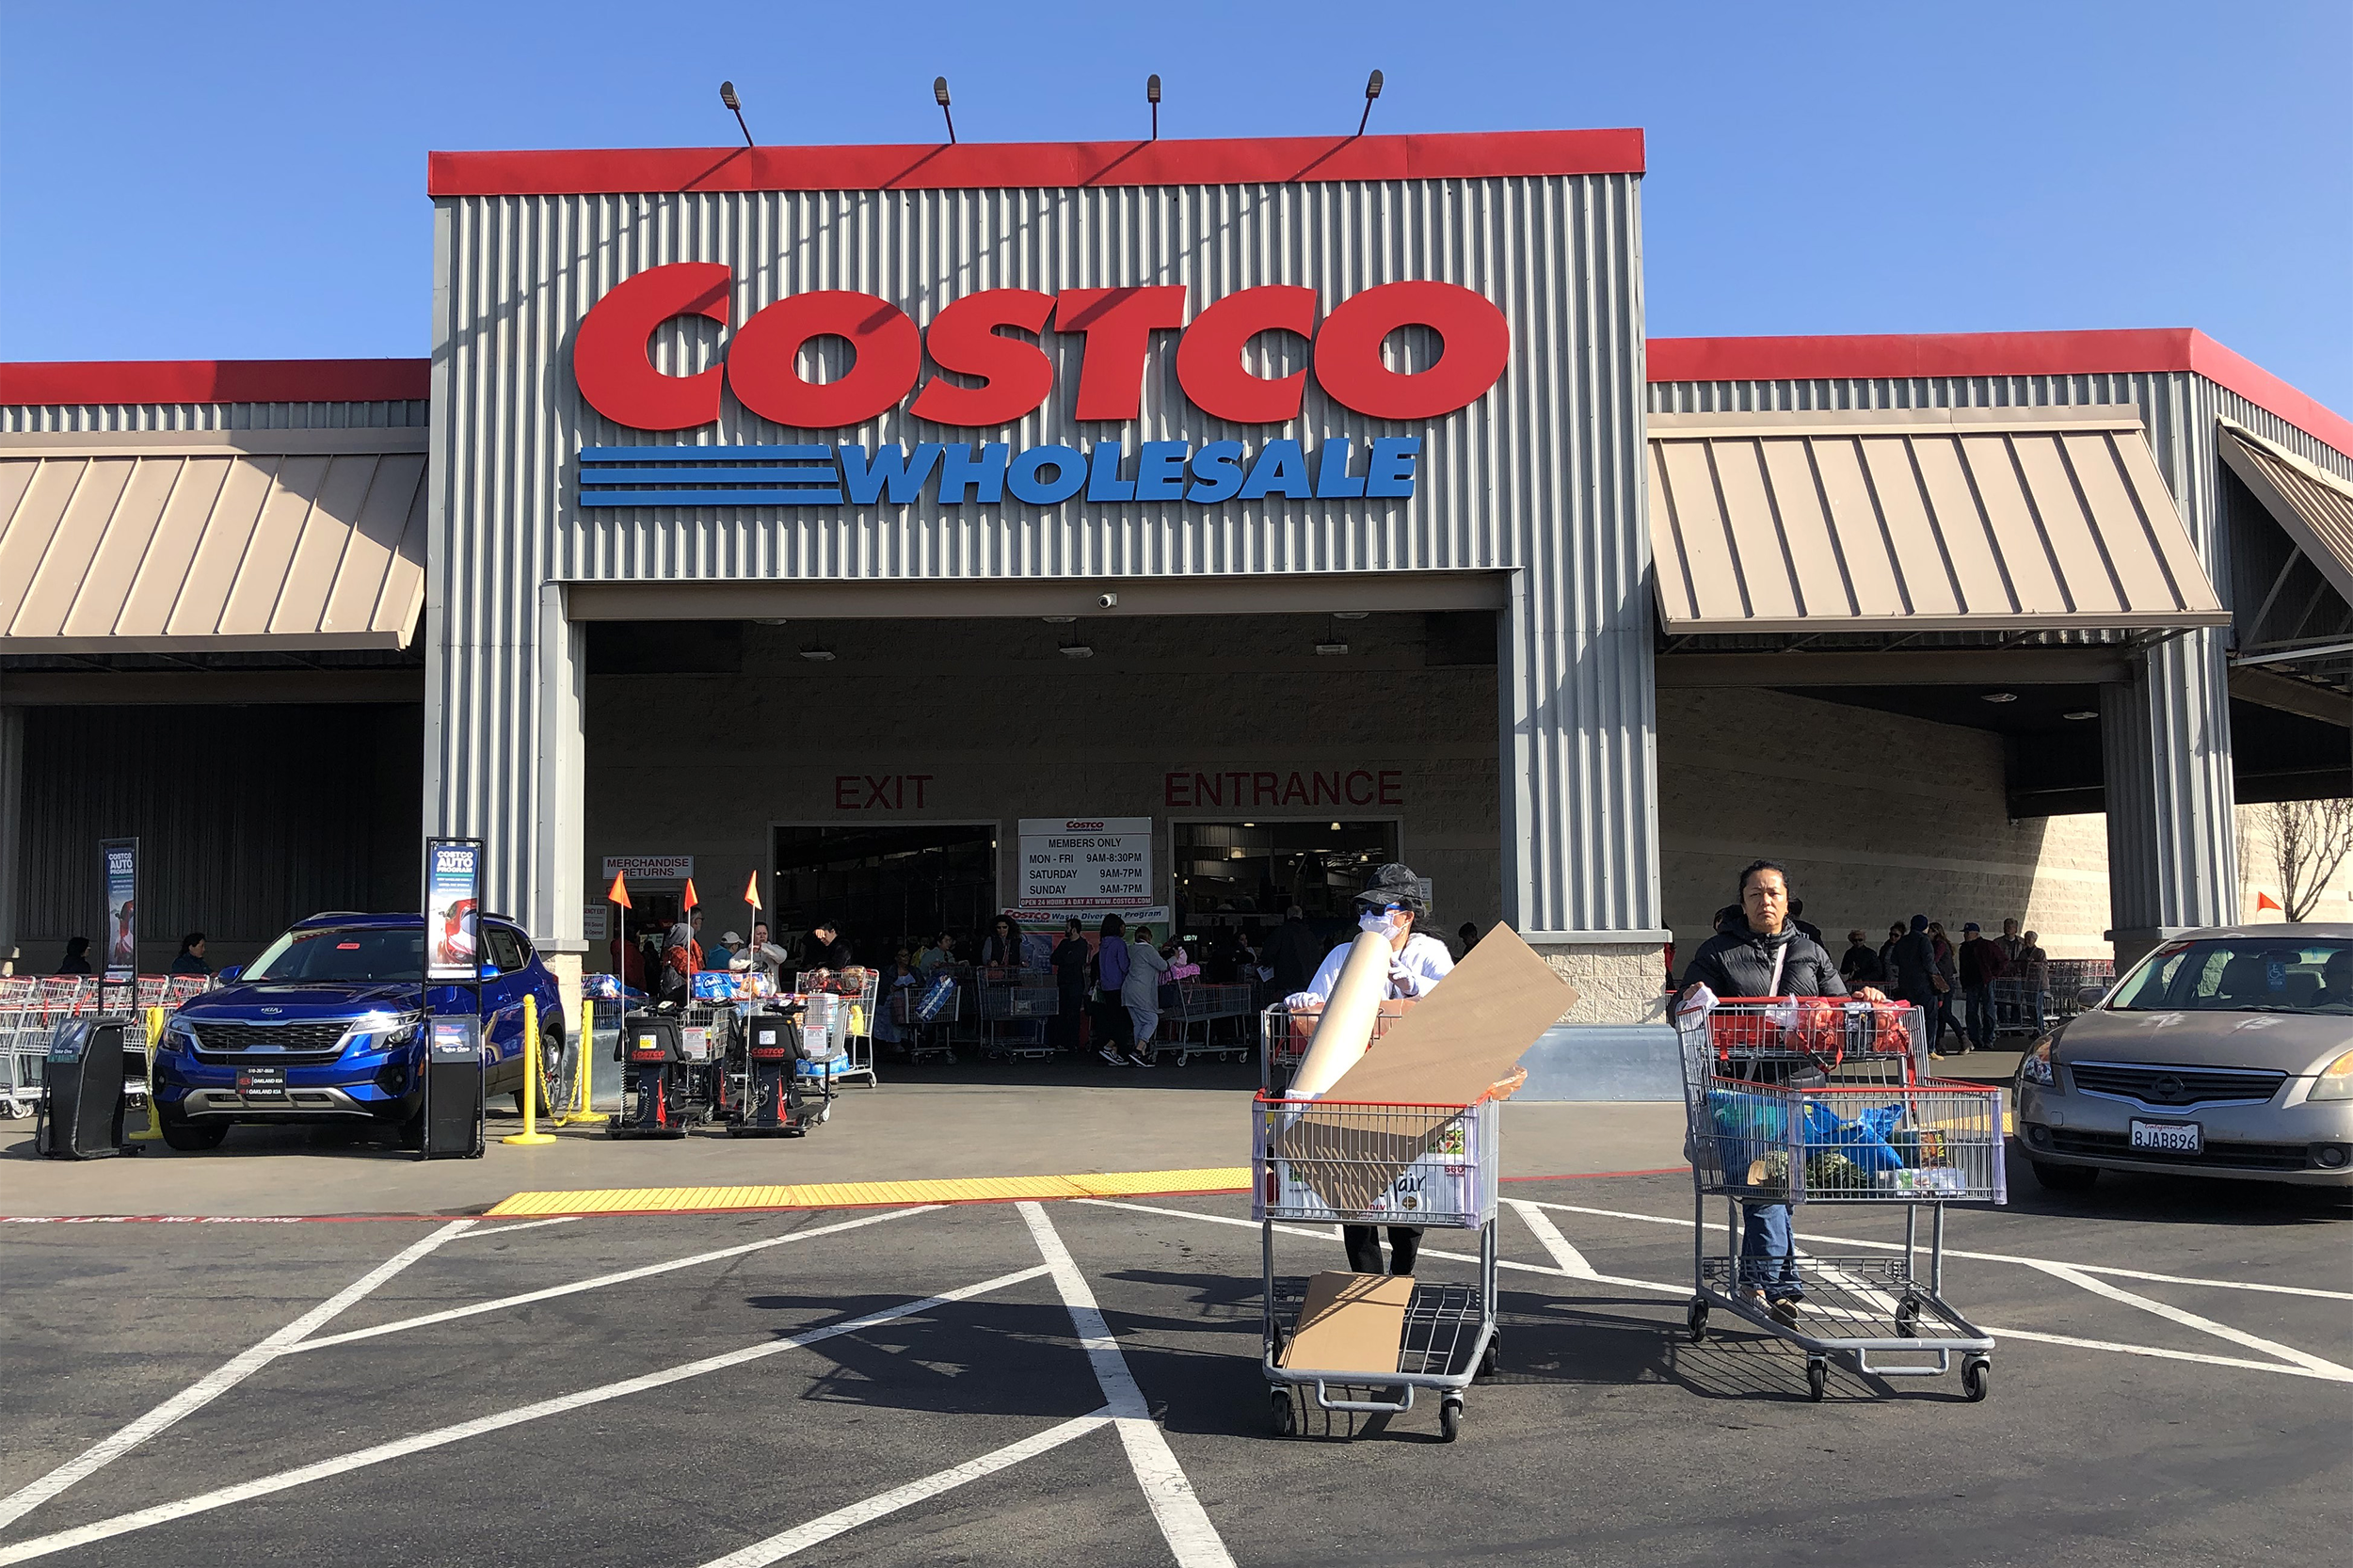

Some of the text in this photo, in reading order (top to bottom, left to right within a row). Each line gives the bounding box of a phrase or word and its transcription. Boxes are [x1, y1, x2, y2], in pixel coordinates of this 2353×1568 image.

[573, 262, 1508, 430] COSTCO
[840, 437, 1420, 504] WHOLESALE
[835, 775, 934, 809] EXIT
[1165, 770, 1404, 807] ENTRANCE
[1048, 838, 1122, 848] MEMBERS ONLY
[437, 857, 473, 868] AUTO
[607, 858, 689, 868] MERCHANDISE
[1030, 855, 1050, 864] MON
[1059, 854, 1074, 863] FRI
[1086, 853, 1142, 863] 9AM-8:30PM
[110, 859, 133, 870] AUTO
[622, 868, 675, 876] RETURNS
[1030, 869, 1142, 879] SATURDAY 9AM-7PM
[1030, 884, 1142, 894] SUNDAY 9AM-7PM
[2135, 1130, 2196, 1149] 8JAB896
